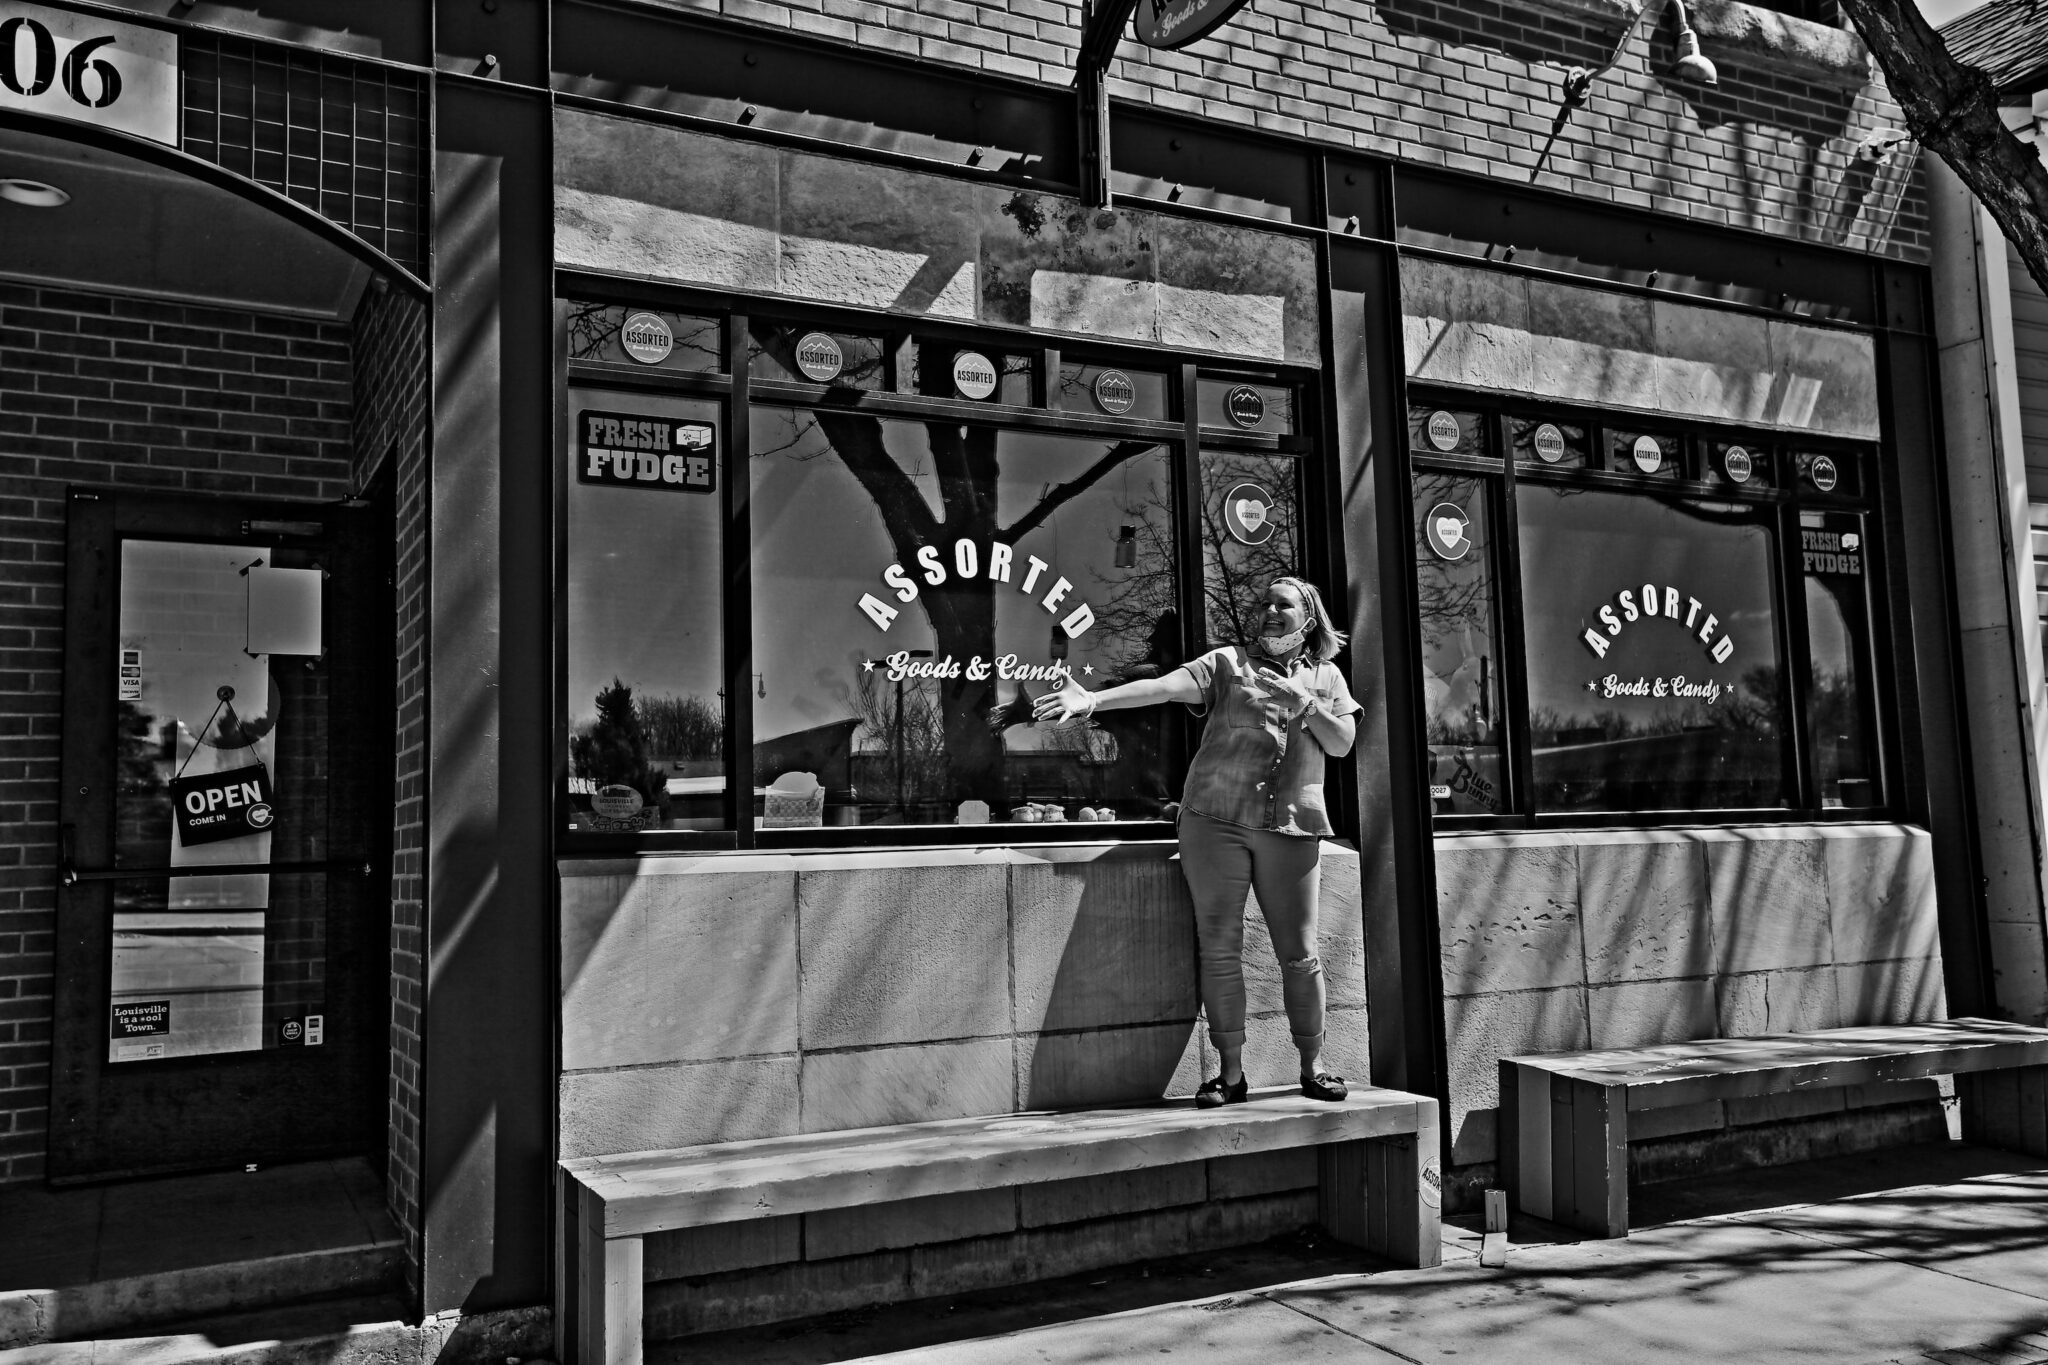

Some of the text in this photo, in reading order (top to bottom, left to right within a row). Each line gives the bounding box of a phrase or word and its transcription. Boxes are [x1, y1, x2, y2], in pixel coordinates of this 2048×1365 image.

[1161, 0, 1196, 37] Goods
[0, 17, 122, 108] 06
[626, 331, 669, 347] ASSORTED
[800, 350, 839, 366] ASSORTED
[957, 370, 993, 384] ASSORTED
[1099, 385, 1132, 399] ASSORTED
[587, 416, 671, 452] FRESH
[1431, 426, 1458, 438] ASSORTED
[1537, 438, 1562, 450] ASSORTED
[1636, 449, 1659, 461] ASSORTED
[587, 448, 710, 486] FUDGE
[1801, 530, 1840, 552] FRESH
[1802, 551, 1860, 575] FUDGE
[858, 538, 1096, 640] ASSORTED
[1584, 583, 1734, 664] ASSORTED
[885, 650, 961, 682] Goods
[965, 655, 992, 681] &
[1602, 673, 1721, 705] Goods & Candy
[185, 780, 263, 814] OPEN
[189, 815, 215, 826] COME
[114, 1005, 168, 1016] Louisville
[119, 1016, 129, 1024] is
[140, 1013, 162, 1022] ool
[125, 1024, 157, 1033] Town.
